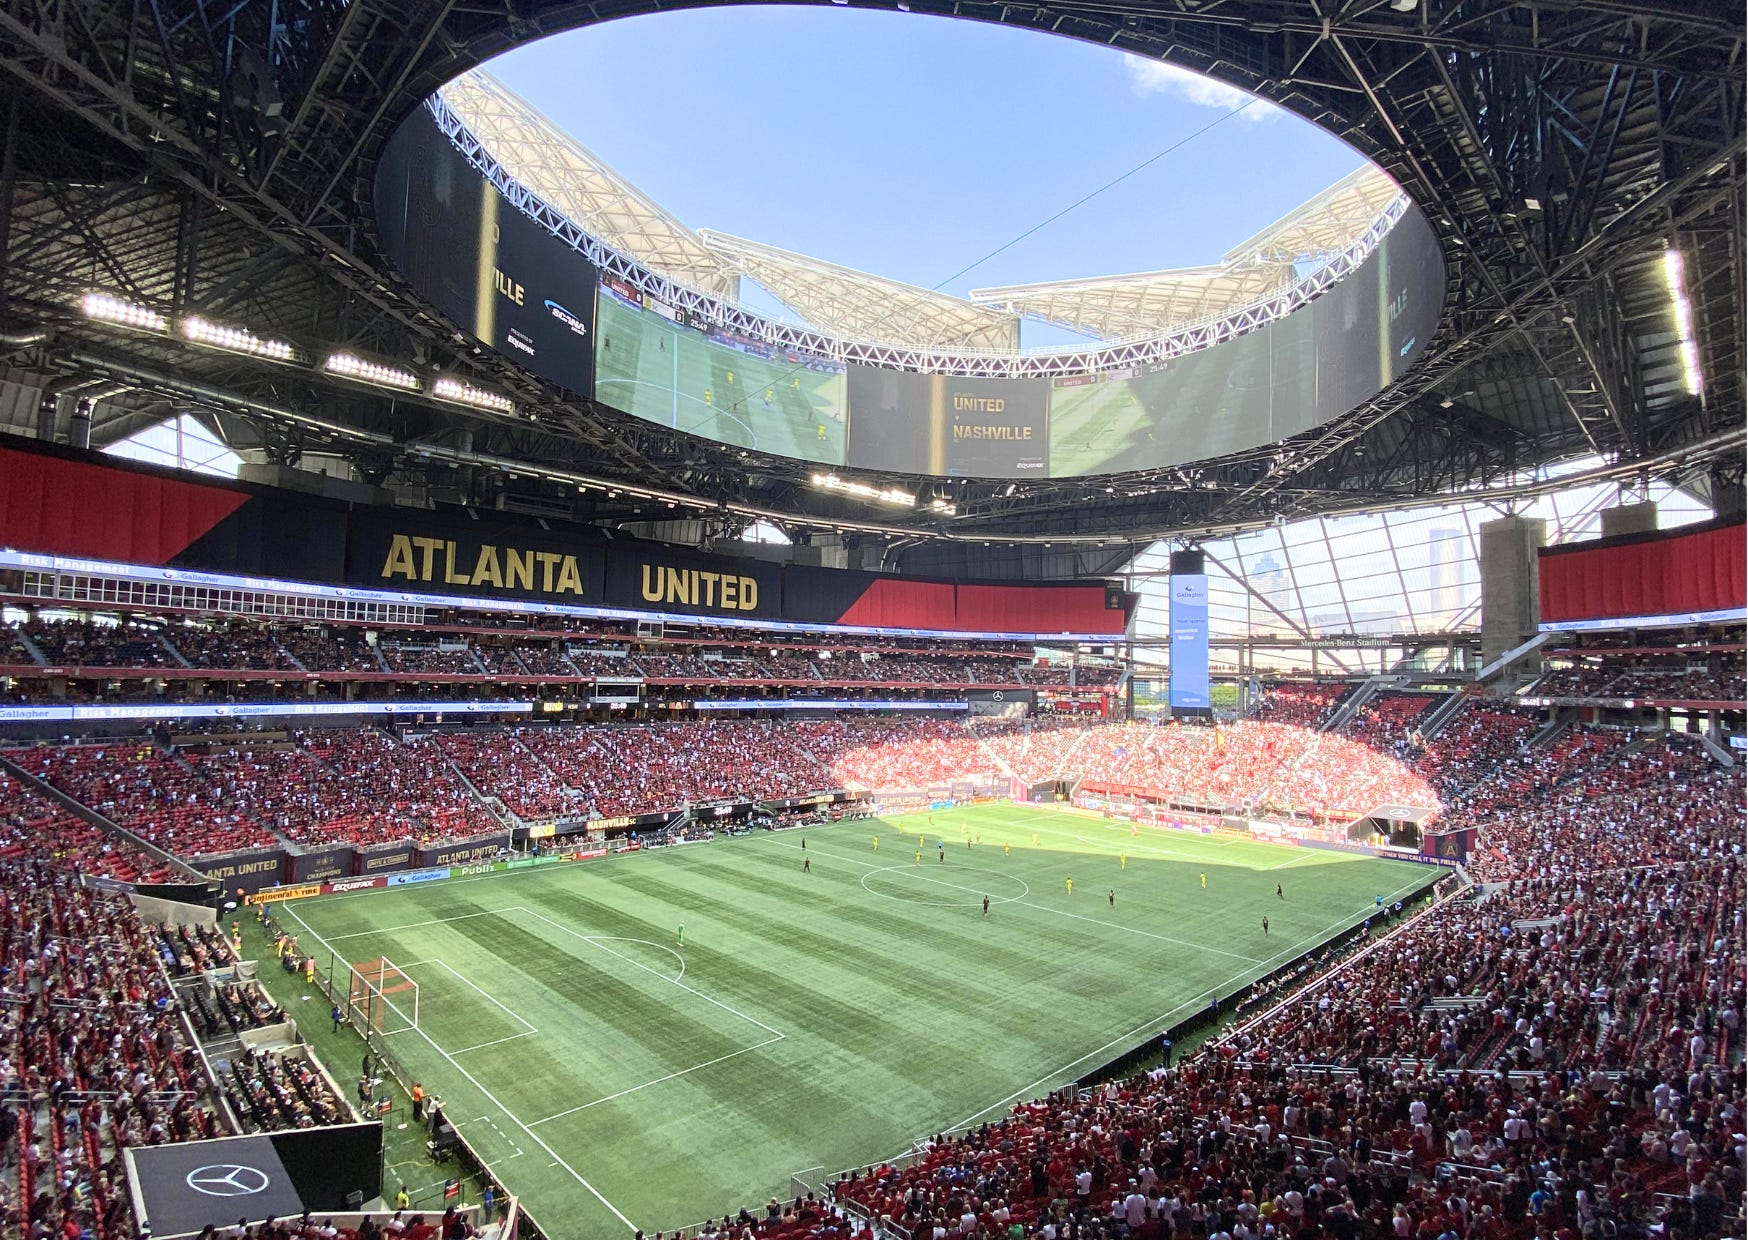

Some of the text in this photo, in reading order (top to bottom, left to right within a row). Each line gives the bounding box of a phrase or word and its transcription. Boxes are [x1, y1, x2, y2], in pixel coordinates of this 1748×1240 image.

[611, 282, 629, 297] UNITED
[690, 319, 708, 331] 25:49
[507, 334, 536, 356] EQUIFAX
[1150, 364, 1168, 373] 25:49
[954, 397, 1005, 412] UNITED
[953, 425, 1032, 440] NASHVILLE
[21, 554, 130, 574] Risk Management
[181, 572, 219, 584] Gallagher
[381, 534, 758, 611] ATLANTA UNITED
[245, 578, 321, 594] Risk Management
[349, 590, 382, 599] Gallagher
[1300, 639, 1356, 647] Mercedes-Benz
[80, 707, 183, 717] Risk Management
[232, 706, 269, 714] Gallagher
[481, 704, 509, 712] Gallagher
[0, 710, 49, 719] Gallagher
[587, 816, 629, 831] NASHVILLE
[436, 844, 499, 865] ATLANTA UNITED
[238, 859, 278, 875] UNITED
[461, 864, 495, 876] Publix
[411, 872, 441, 880] Gallagher
[301, 887, 318, 895] TIRE
[332, 880, 376, 892] EQUIFAX
